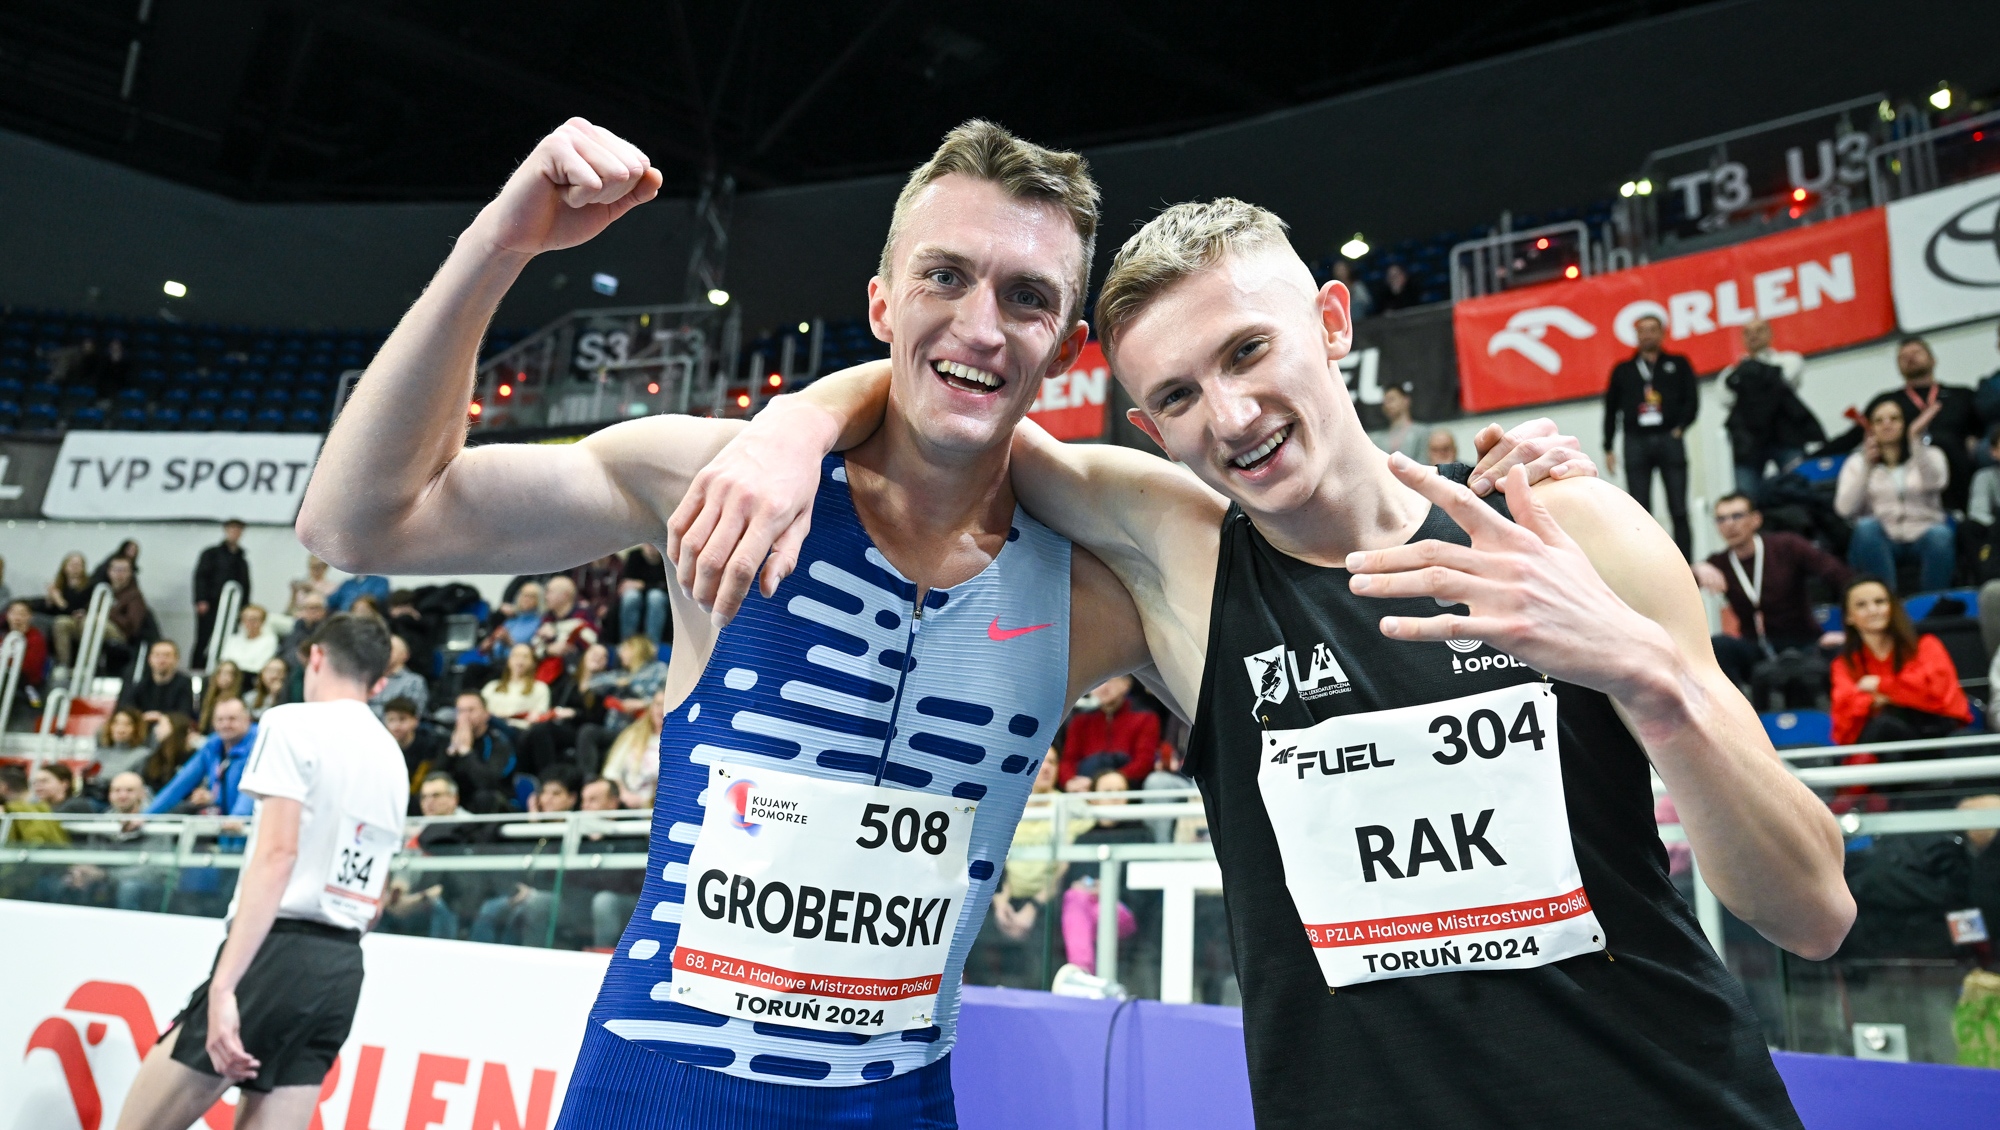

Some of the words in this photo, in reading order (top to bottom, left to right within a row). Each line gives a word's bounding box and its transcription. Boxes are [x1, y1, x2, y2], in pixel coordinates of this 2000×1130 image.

[1785, 131, 1870, 190] U3
[1666, 162, 1752, 220] T3
[1612, 252, 1856, 348] ORLEN
[575, 332, 629, 370] S3
[68, 458, 150, 491] TVP
[162, 458, 308, 493] SPORT
[1428, 701, 1546, 766] 304
[1297, 742, 1395, 779] FUEL
[751, 808, 808, 825] POMORZE
[752, 796, 798, 811] KUJAWY
[855, 803, 950, 856] 508
[1354, 808, 1507, 882] RAK
[337, 848, 374, 891] 354
[697, 868, 951, 948] GROBERSKI
[1326, 926, 1365, 943] PZLA
[1368, 921, 1433, 938] Halowe
[1437, 906, 1544, 931] Mistrzostwa
[1549, 892, 1587, 917] Polski
[685, 953, 707, 970] 68.
[711, 959, 745, 979] PZLA
[750, 967, 806, 991] Halowe
[810, 979, 898, 997] Mistrzostwa
[901, 978, 933, 996] Polski
[1363, 940, 1461, 973] TORUŃ
[1467, 936, 1539, 963] 2024
[735, 992, 820, 1021] TORUŃ
[825, 1005, 884, 1027] 2024
[203, 1044, 557, 1130] LEN
